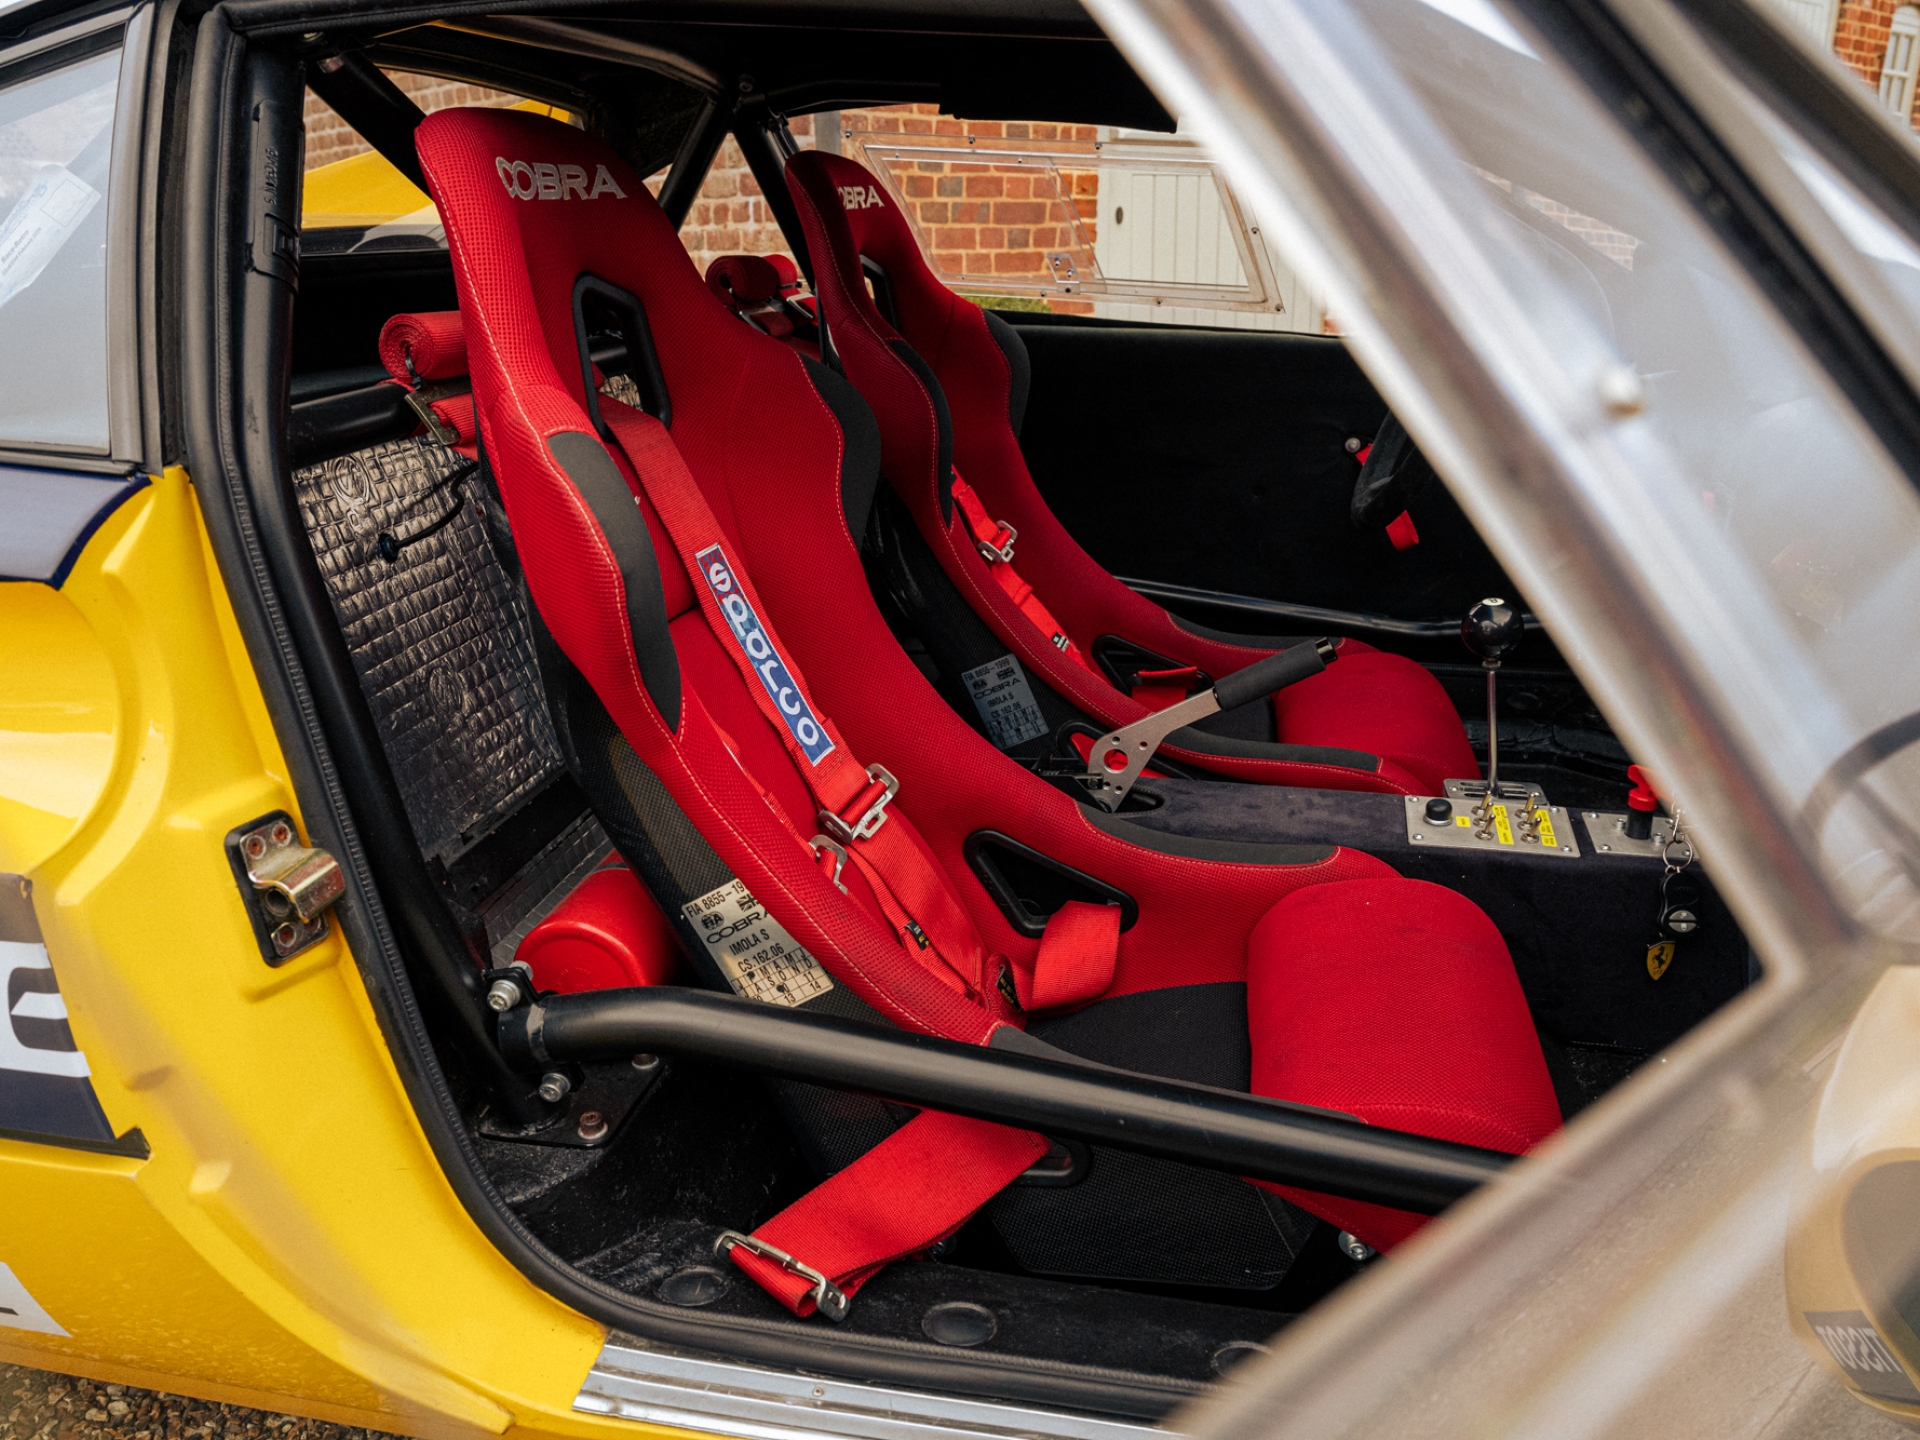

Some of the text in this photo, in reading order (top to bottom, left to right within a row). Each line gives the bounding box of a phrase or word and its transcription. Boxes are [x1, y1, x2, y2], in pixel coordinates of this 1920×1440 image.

[494, 156, 628, 201] COBRA
[837, 185, 885, 210] BRA
[709, 562, 820, 746] sparco
[973, 677, 1021, 699] COBRA
[685, 902, 704, 918] FIA
[707, 910, 769, 944] COBR
[729, 929, 770, 956] IMOLA S
[738, 943, 785, 973] CS.162.06
[773, 960, 782, 971] A
[754, 983, 762, 993] A
[767, 976, 775, 986] S
[803, 971, 815, 982] 11
[784, 980, 821, 1004] 13 14
